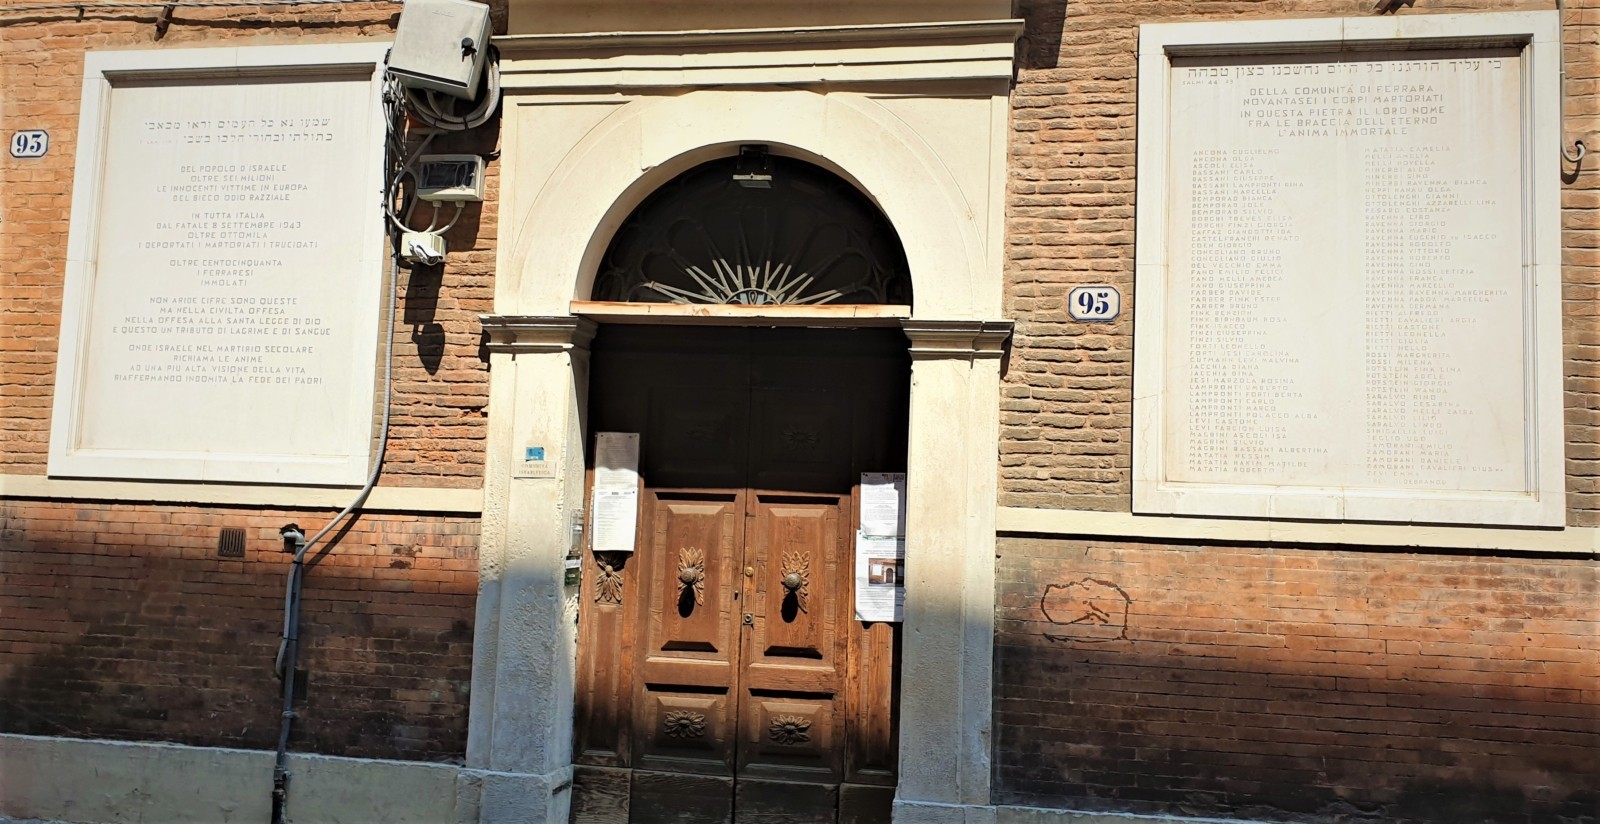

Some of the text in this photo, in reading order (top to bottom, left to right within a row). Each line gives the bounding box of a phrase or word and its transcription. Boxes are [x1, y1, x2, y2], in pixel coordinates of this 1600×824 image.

[1250, 87, 1288, 96] DELLA
[1360, 85, 1371, 94] DI
[1377, 84, 1434, 94] FERRARA
[1243, 96, 1318, 106] NOVANTASEI
[1332, 96, 1368, 104] CORPI
[1373, 95, 1443, 104] MARTORIATI
[1240, 105, 1445, 118] IN QUESTA PIETRA IL LORO NOME
[1248, 120, 1270, 128] FRA
[1276, 119, 1290, 127] LE
[1297, 118, 1350, 127] BRACCIA
[1335, 128, 1408, 137] IMMORTALE
[17, 134, 42, 153] 93
[1078, 292, 1109, 314] 95
[121, 326, 158, 335] QUESTO
[161, 326, 172, 335] UN
[176, 327, 214, 335] TRIBUTO
[217, 327, 226, 335] DI
[230, 327, 269, 335] LAGRIME
[295, 328, 331, 336] SANGUE
[156, 344, 192, 352] ISRAELE
[196, 344, 213, 352] NEL
[216, 345, 261, 353] MARTIRIO
[265, 345, 313, 354] SECOLARE
[114, 374, 322, 385] RIAFFERMANDO INDOMITA LA FEDE DEI PADRI
